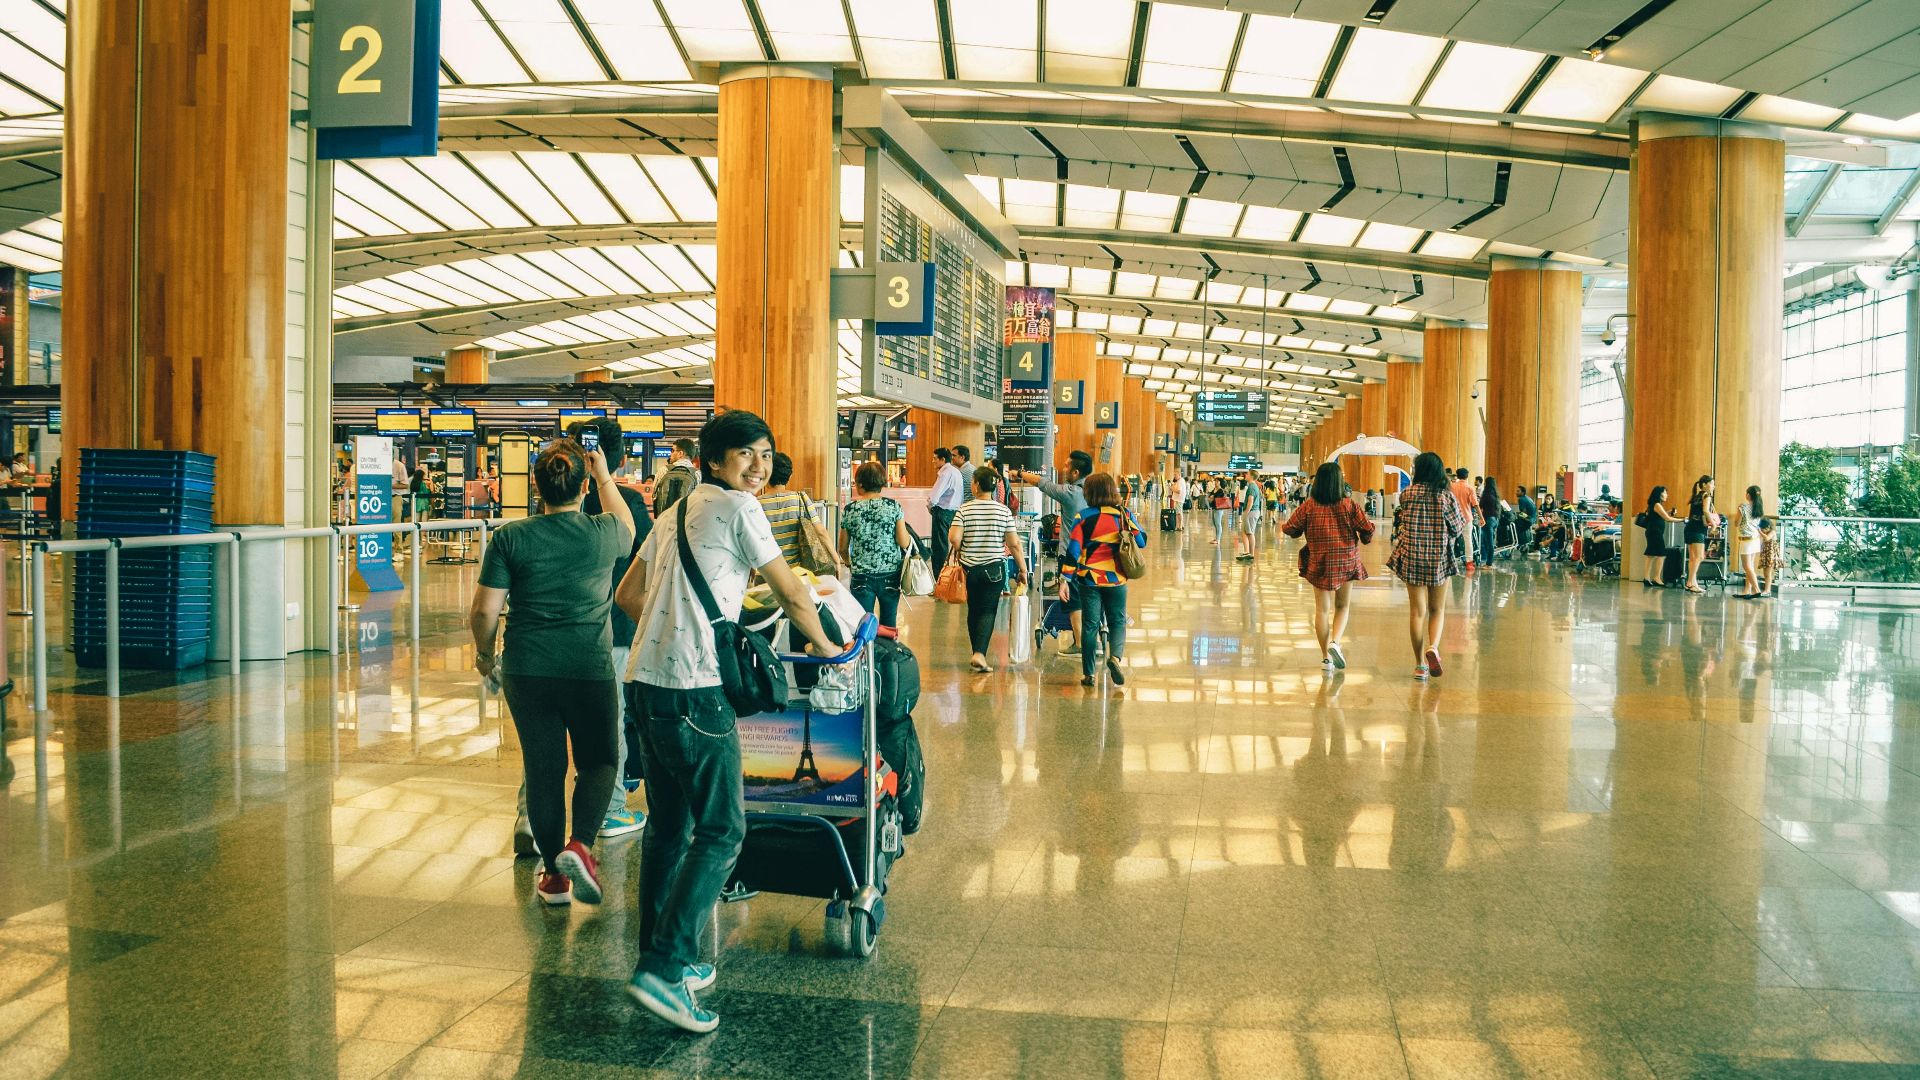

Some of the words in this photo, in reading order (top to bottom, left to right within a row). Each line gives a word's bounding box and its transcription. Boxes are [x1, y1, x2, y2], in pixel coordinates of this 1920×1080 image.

[338, 25, 383, 94] 2
[887, 276, 910, 308] 3
[1018, 351, 1034, 372] 4
[1061, 386, 1073, 402] 5
[1100, 406, 1110, 420] 6
[902, 424, 914, 438] 4
[1157, 436, 1164, 444] 7
[1168, 441, 1174, 449] 8
[359, 496, 382, 514] 60
[359, 540, 379, 558] 10
